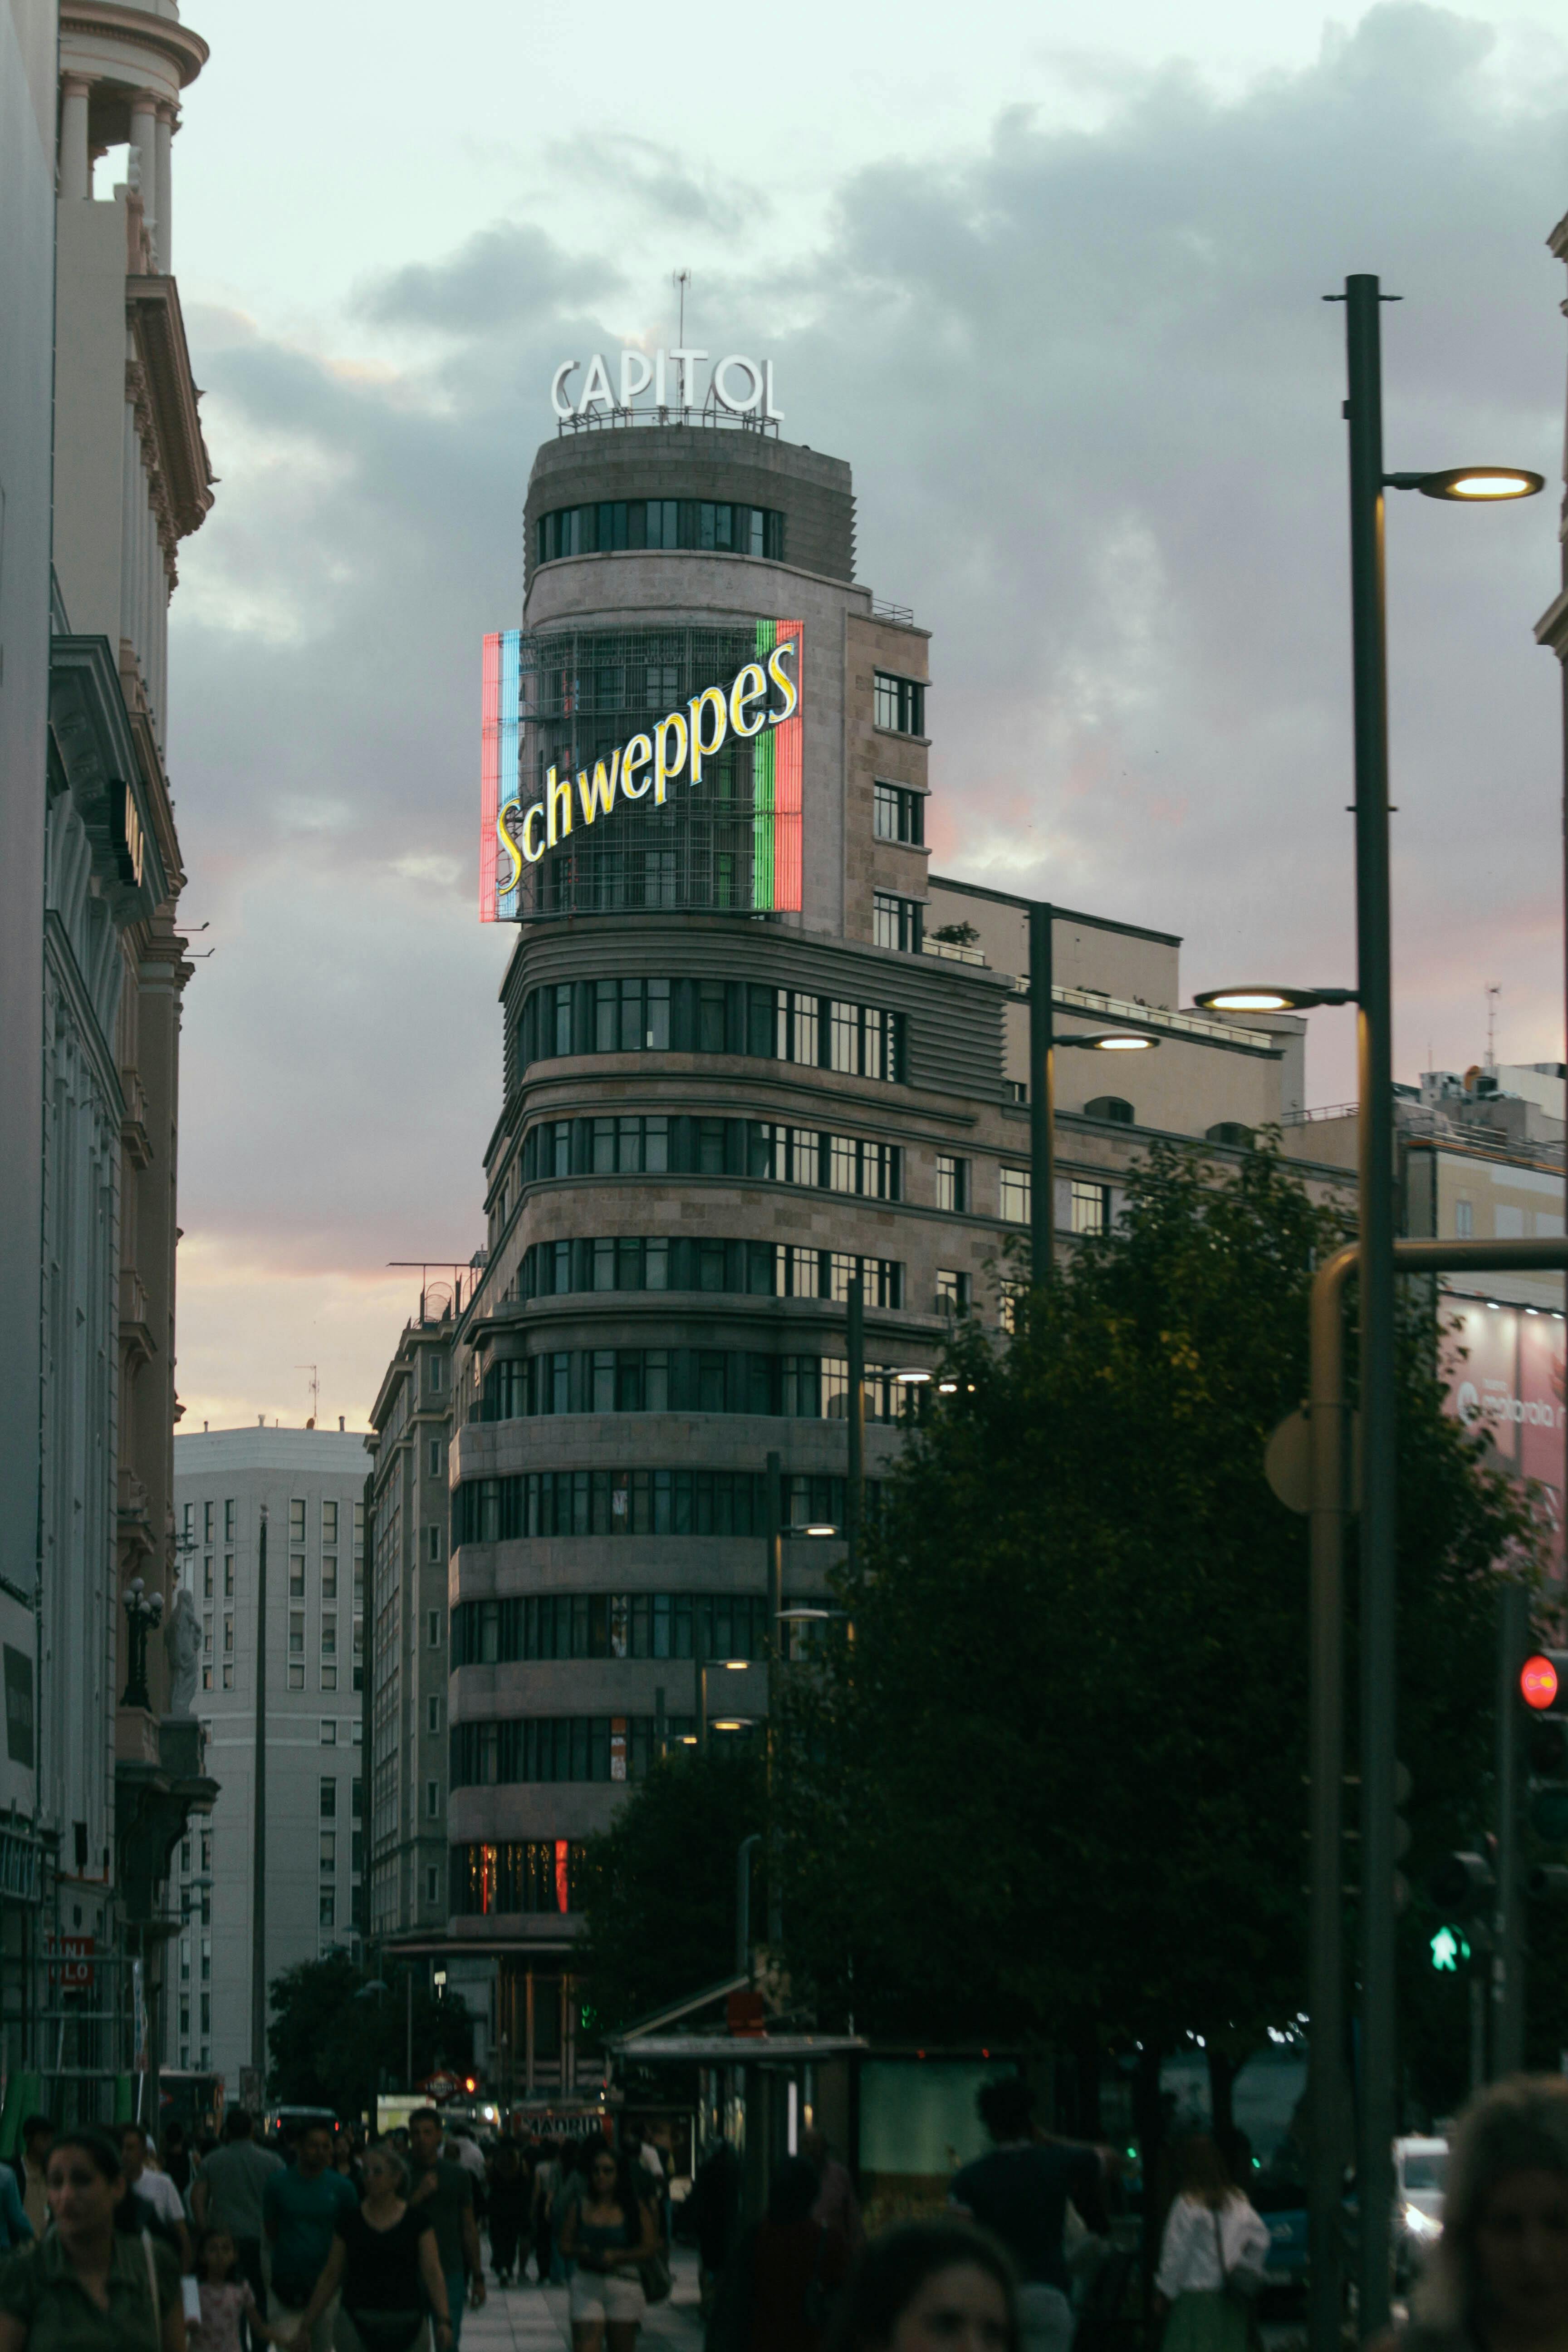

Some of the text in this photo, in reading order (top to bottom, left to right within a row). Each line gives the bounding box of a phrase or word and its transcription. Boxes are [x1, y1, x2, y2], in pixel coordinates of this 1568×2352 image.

[551, 348, 784, 421] CAPITOL
[496, 642, 797, 897] Schweppes
[1482, 1394, 1554, 1428] motorola
